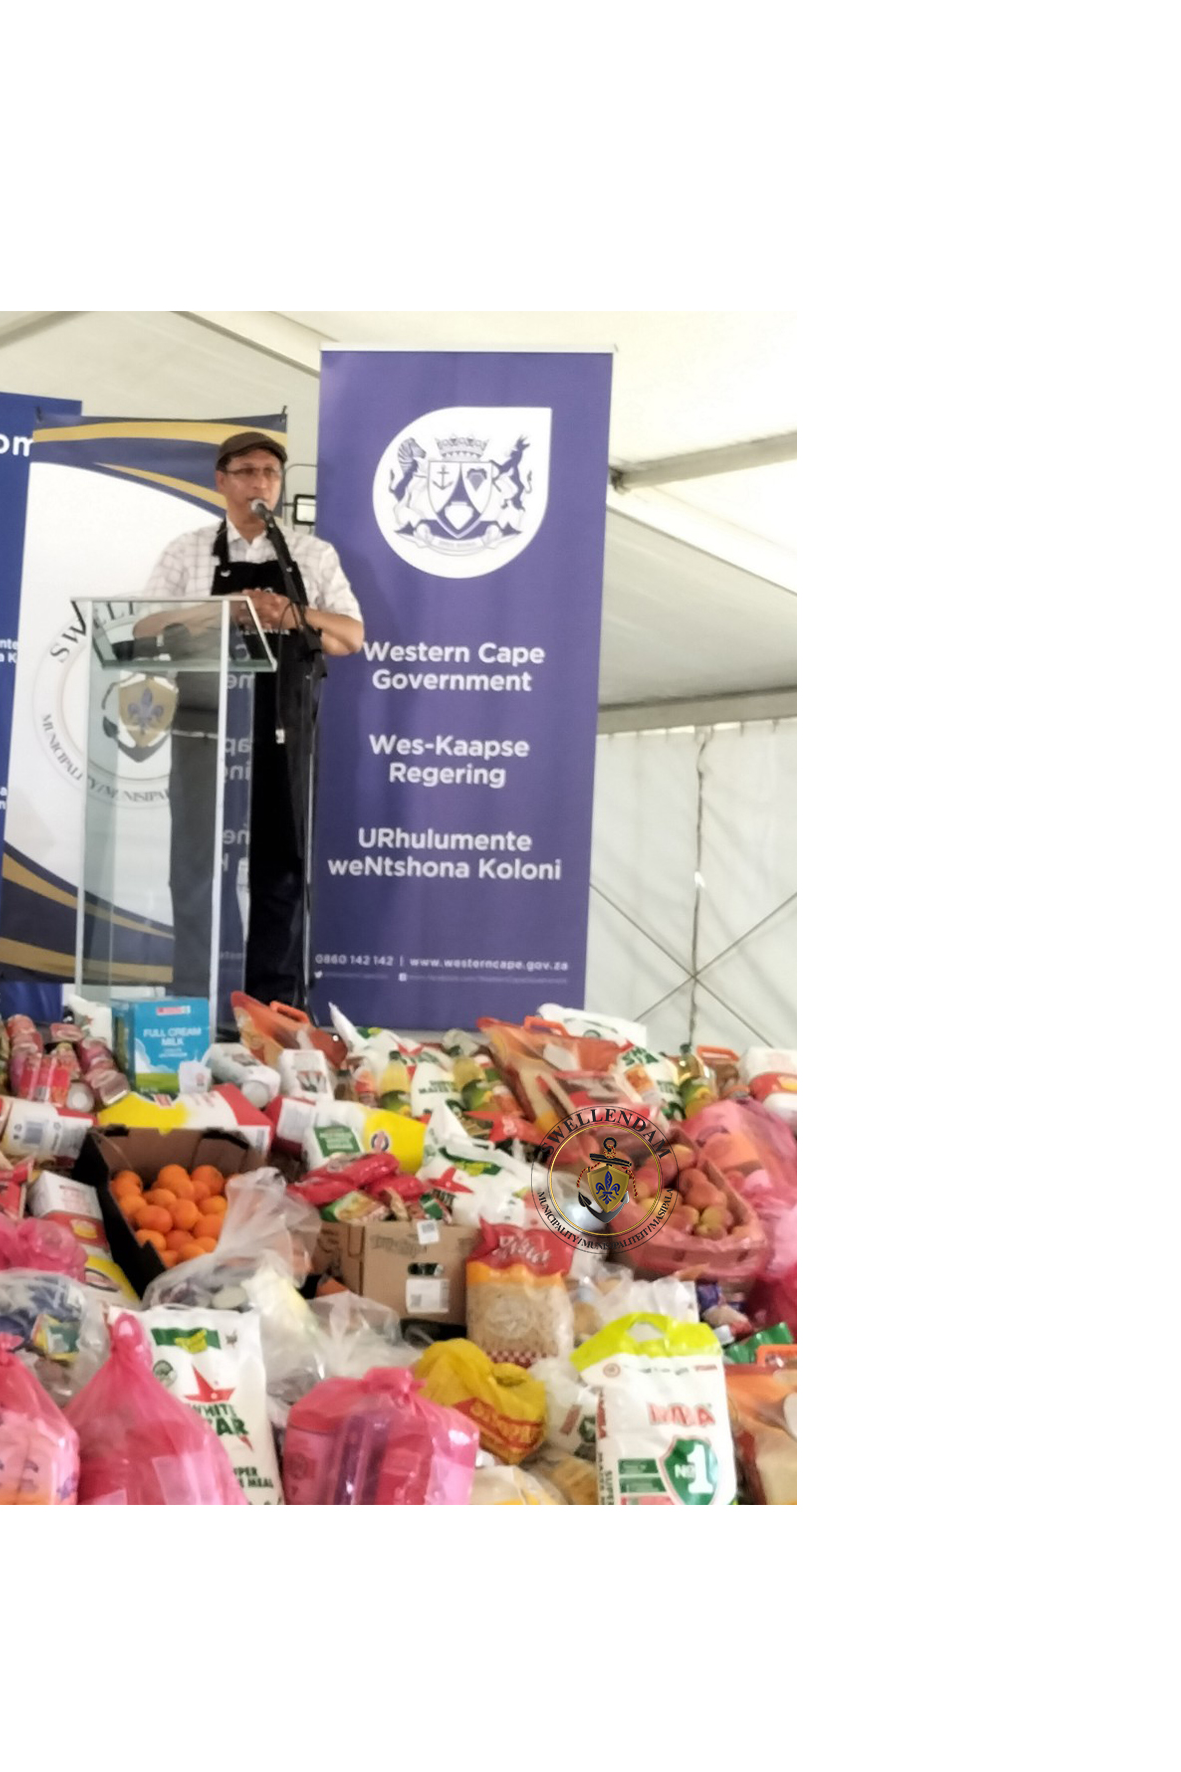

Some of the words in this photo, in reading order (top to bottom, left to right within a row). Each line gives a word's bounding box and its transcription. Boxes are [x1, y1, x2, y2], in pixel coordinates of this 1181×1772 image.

[363, 641, 470, 663] Western
[478, 642, 546, 667] Cape
[372, 668, 533, 692] Government
[369, 734, 530, 761] Wes-Kaapse
[389, 763, 507, 789] Regering
[358, 828, 533, 851] URhulumente
[328, 856, 470, 880] weNtshona
[478, 858, 563, 881] Koloni
[315, 954, 347, 966] 0860
[350, 955, 370, 966] 142
[373, 955, 394, 967] 142
[409, 957, 569, 971] www.westerncape.gov.za
[143, 1028, 166, 1038] FULL
[168, 1027, 202, 1037] CREAM
[161, 1037, 184, 1046] MILK
[215, 1418, 249, 1436] AR
